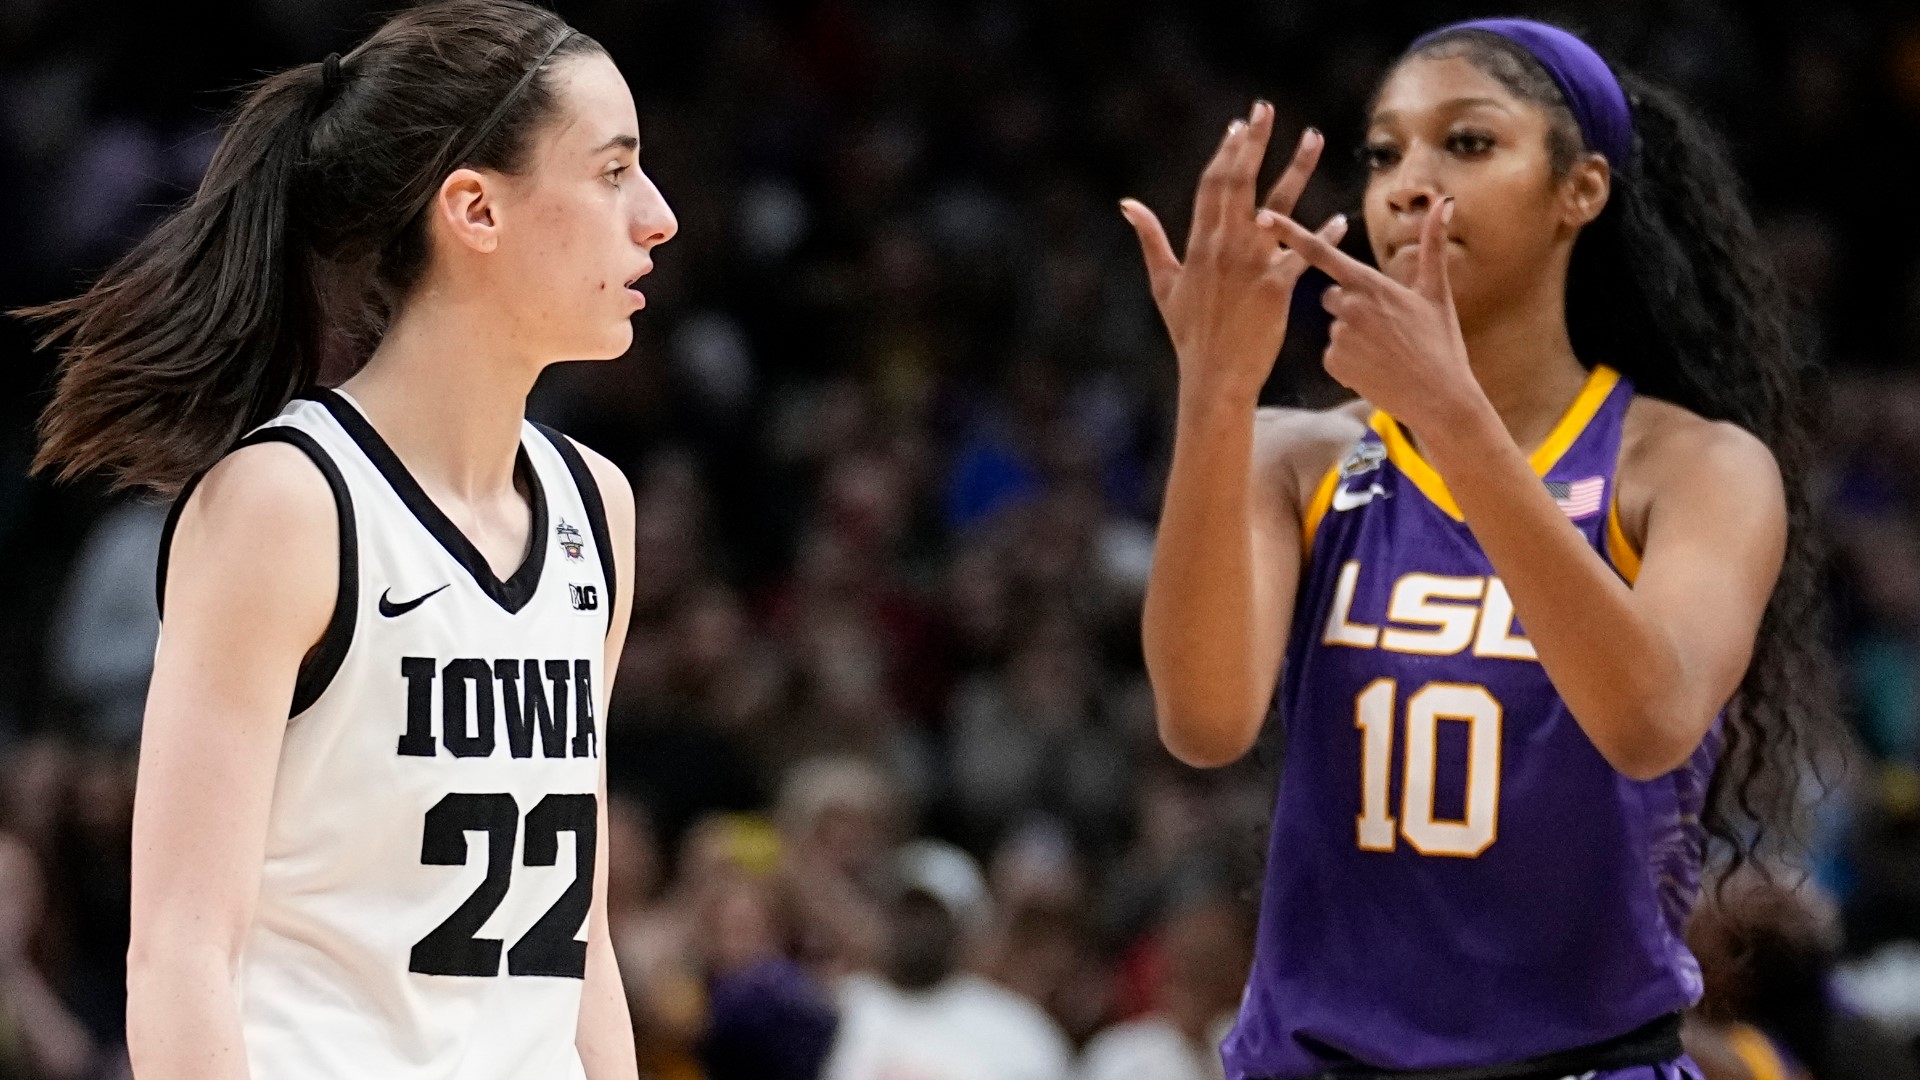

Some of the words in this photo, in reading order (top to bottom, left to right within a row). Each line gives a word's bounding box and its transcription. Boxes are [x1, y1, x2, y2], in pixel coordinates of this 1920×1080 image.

[397, 657, 597, 759] IOWA
[1356, 677, 1503, 858] 10
[409, 792, 598, 978] 22
